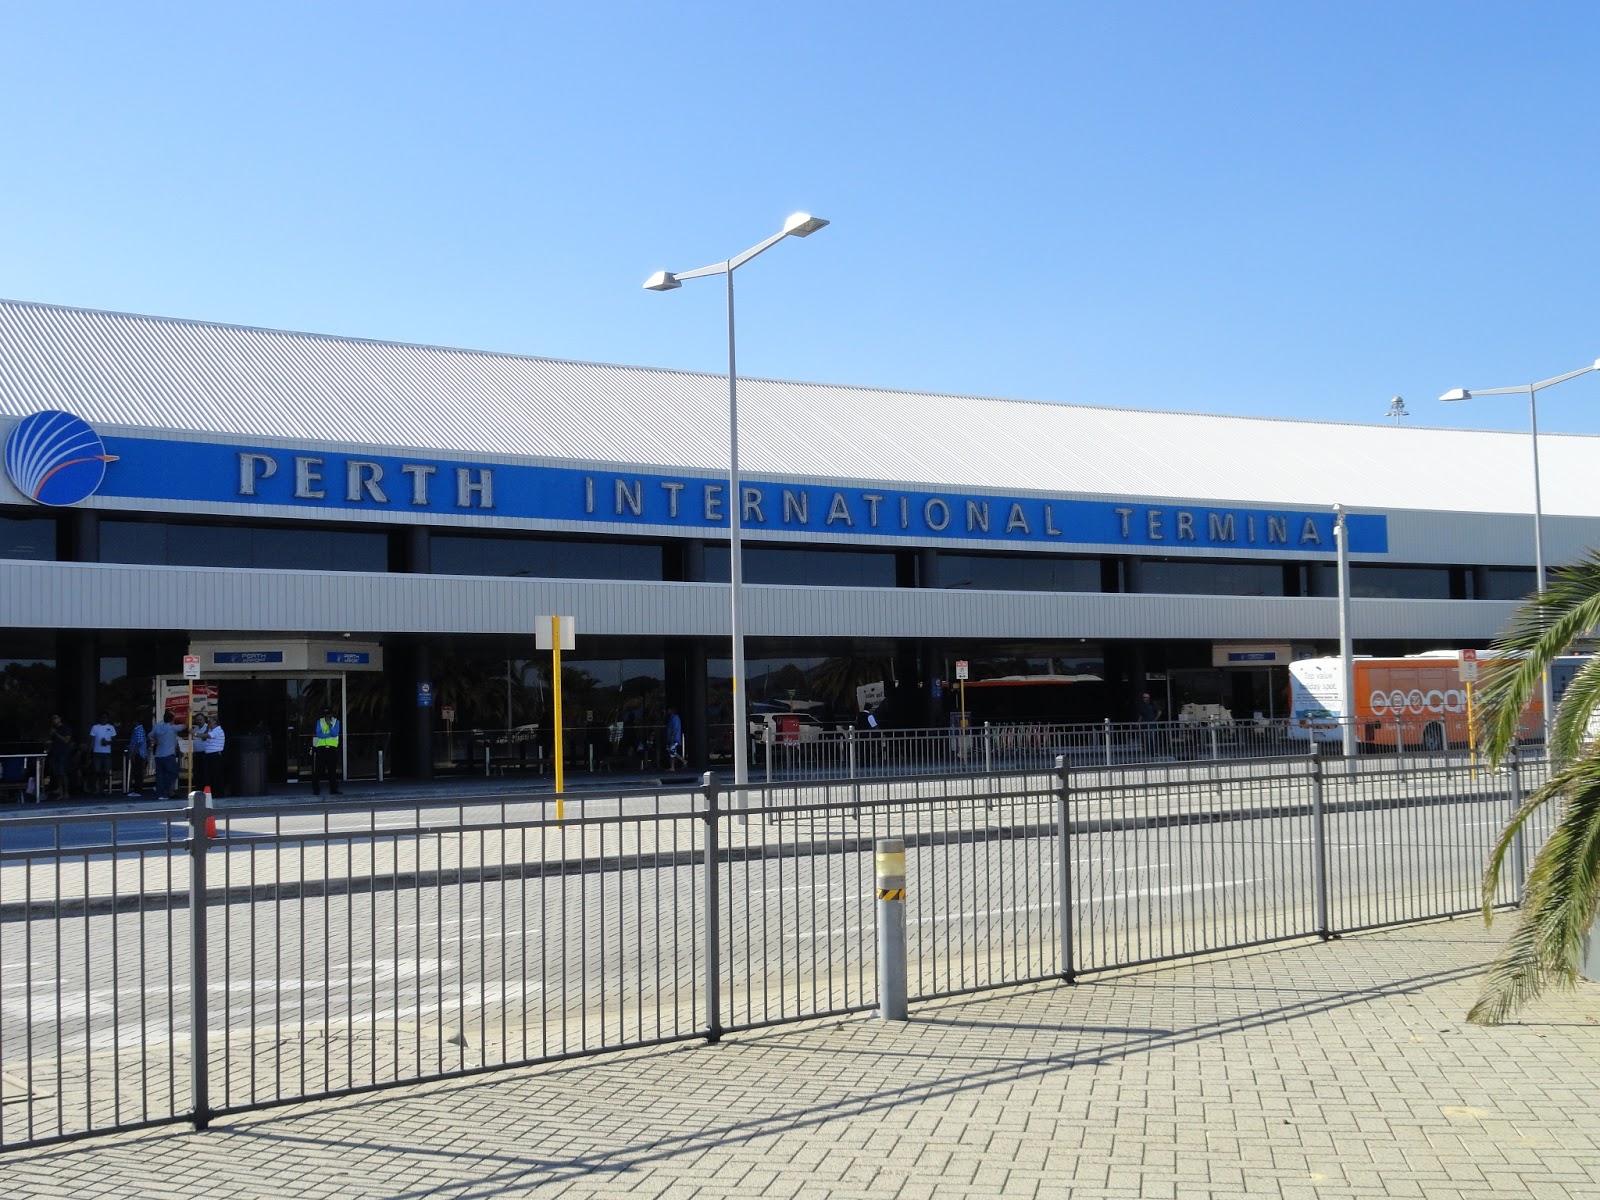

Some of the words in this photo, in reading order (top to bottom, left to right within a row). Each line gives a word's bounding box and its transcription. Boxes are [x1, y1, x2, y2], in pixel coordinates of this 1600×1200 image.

[237, 452, 495, 508] PERTH
[584, 476, 1062, 535] INTERNATIONAL
[1114, 508, 1342, 545] TERMINA
